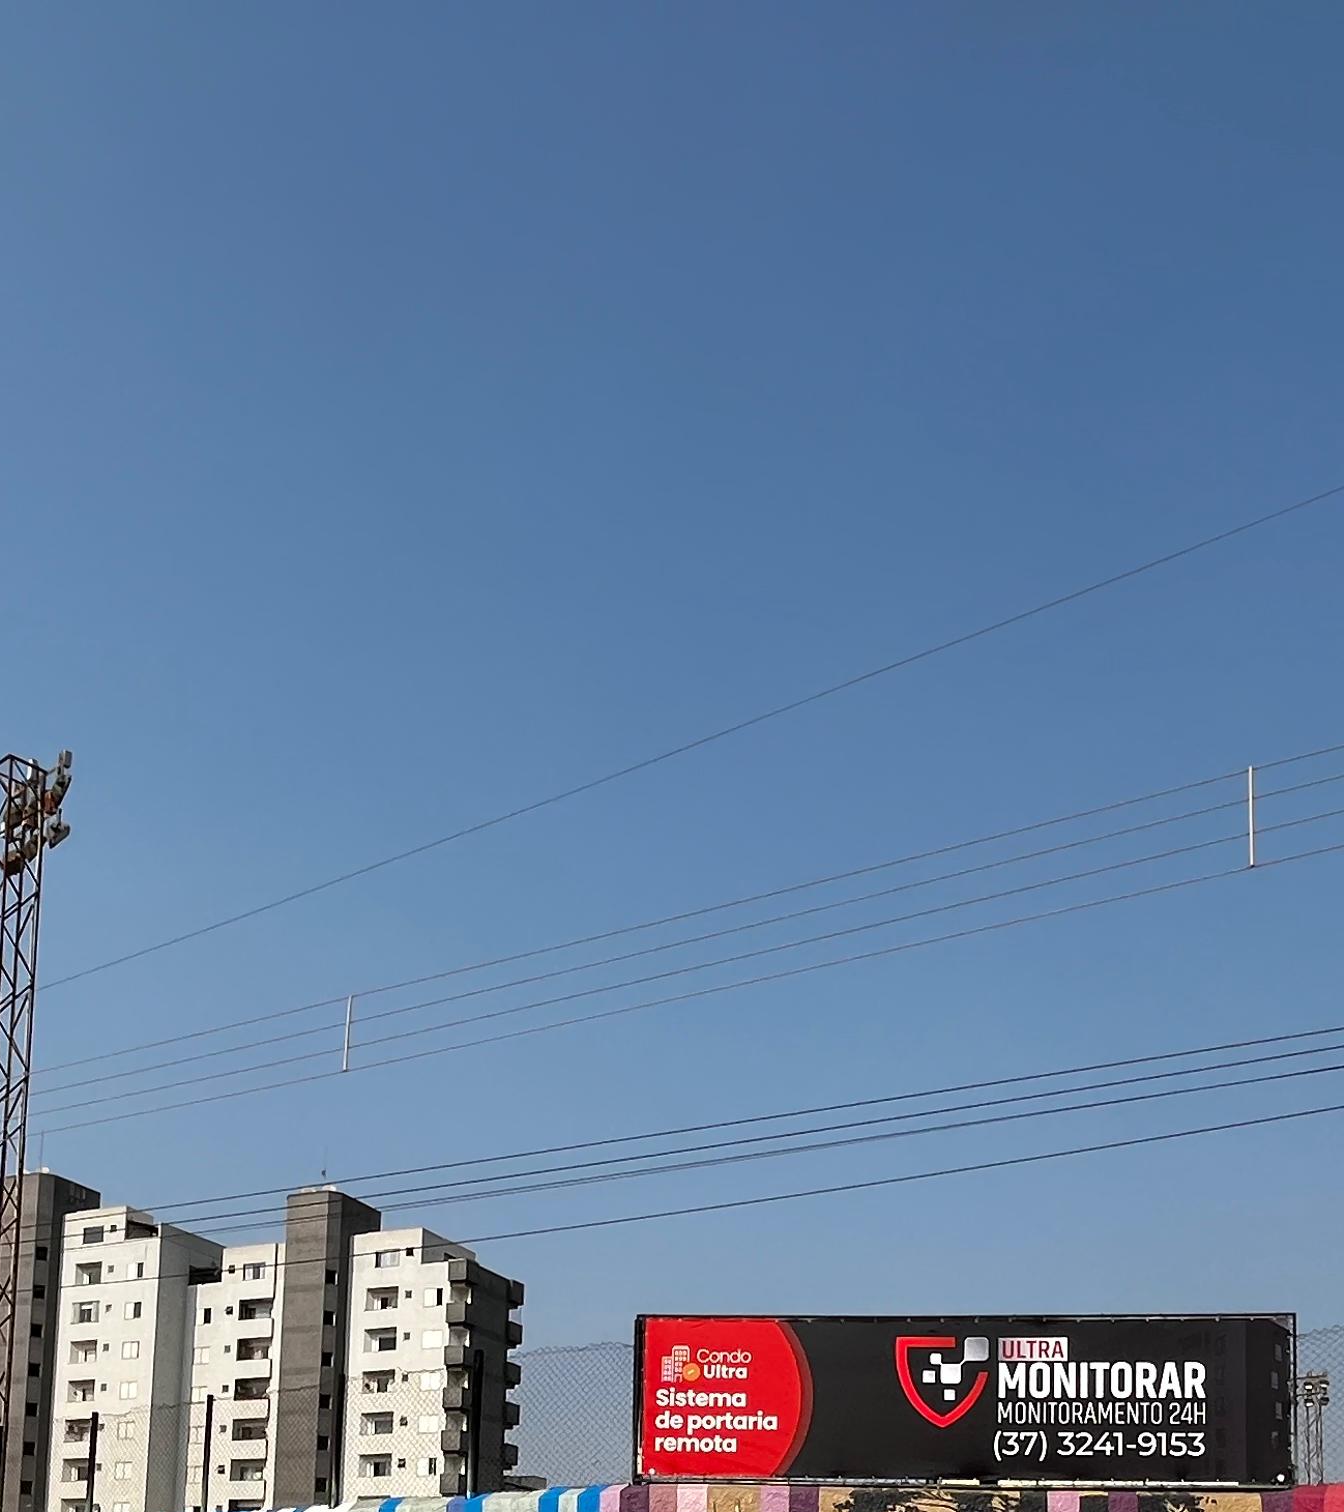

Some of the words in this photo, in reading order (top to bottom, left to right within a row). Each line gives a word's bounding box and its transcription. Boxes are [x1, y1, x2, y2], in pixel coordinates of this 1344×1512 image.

[696, 1348, 752, 1364] Condo
[1002, 1340, 1064, 1359] ULTRA
[703, 1363, 748, 1379] Ultra
[997, 1361, 1206, 1399] MONITORAR
[655, 1387, 747, 1407] Sistema
[654, 1410, 684, 1429] de
[687, 1410, 778, 1435] portaria
[997, 1401, 1163, 1425] MONITORAMENTO
[1168, 1401, 1207, 1425] 24H
[654, 1434, 737, 1453] remota
[993, 1430, 1048, 1462] (37)
[1057, 1431, 1206, 1457] 3241-9153
